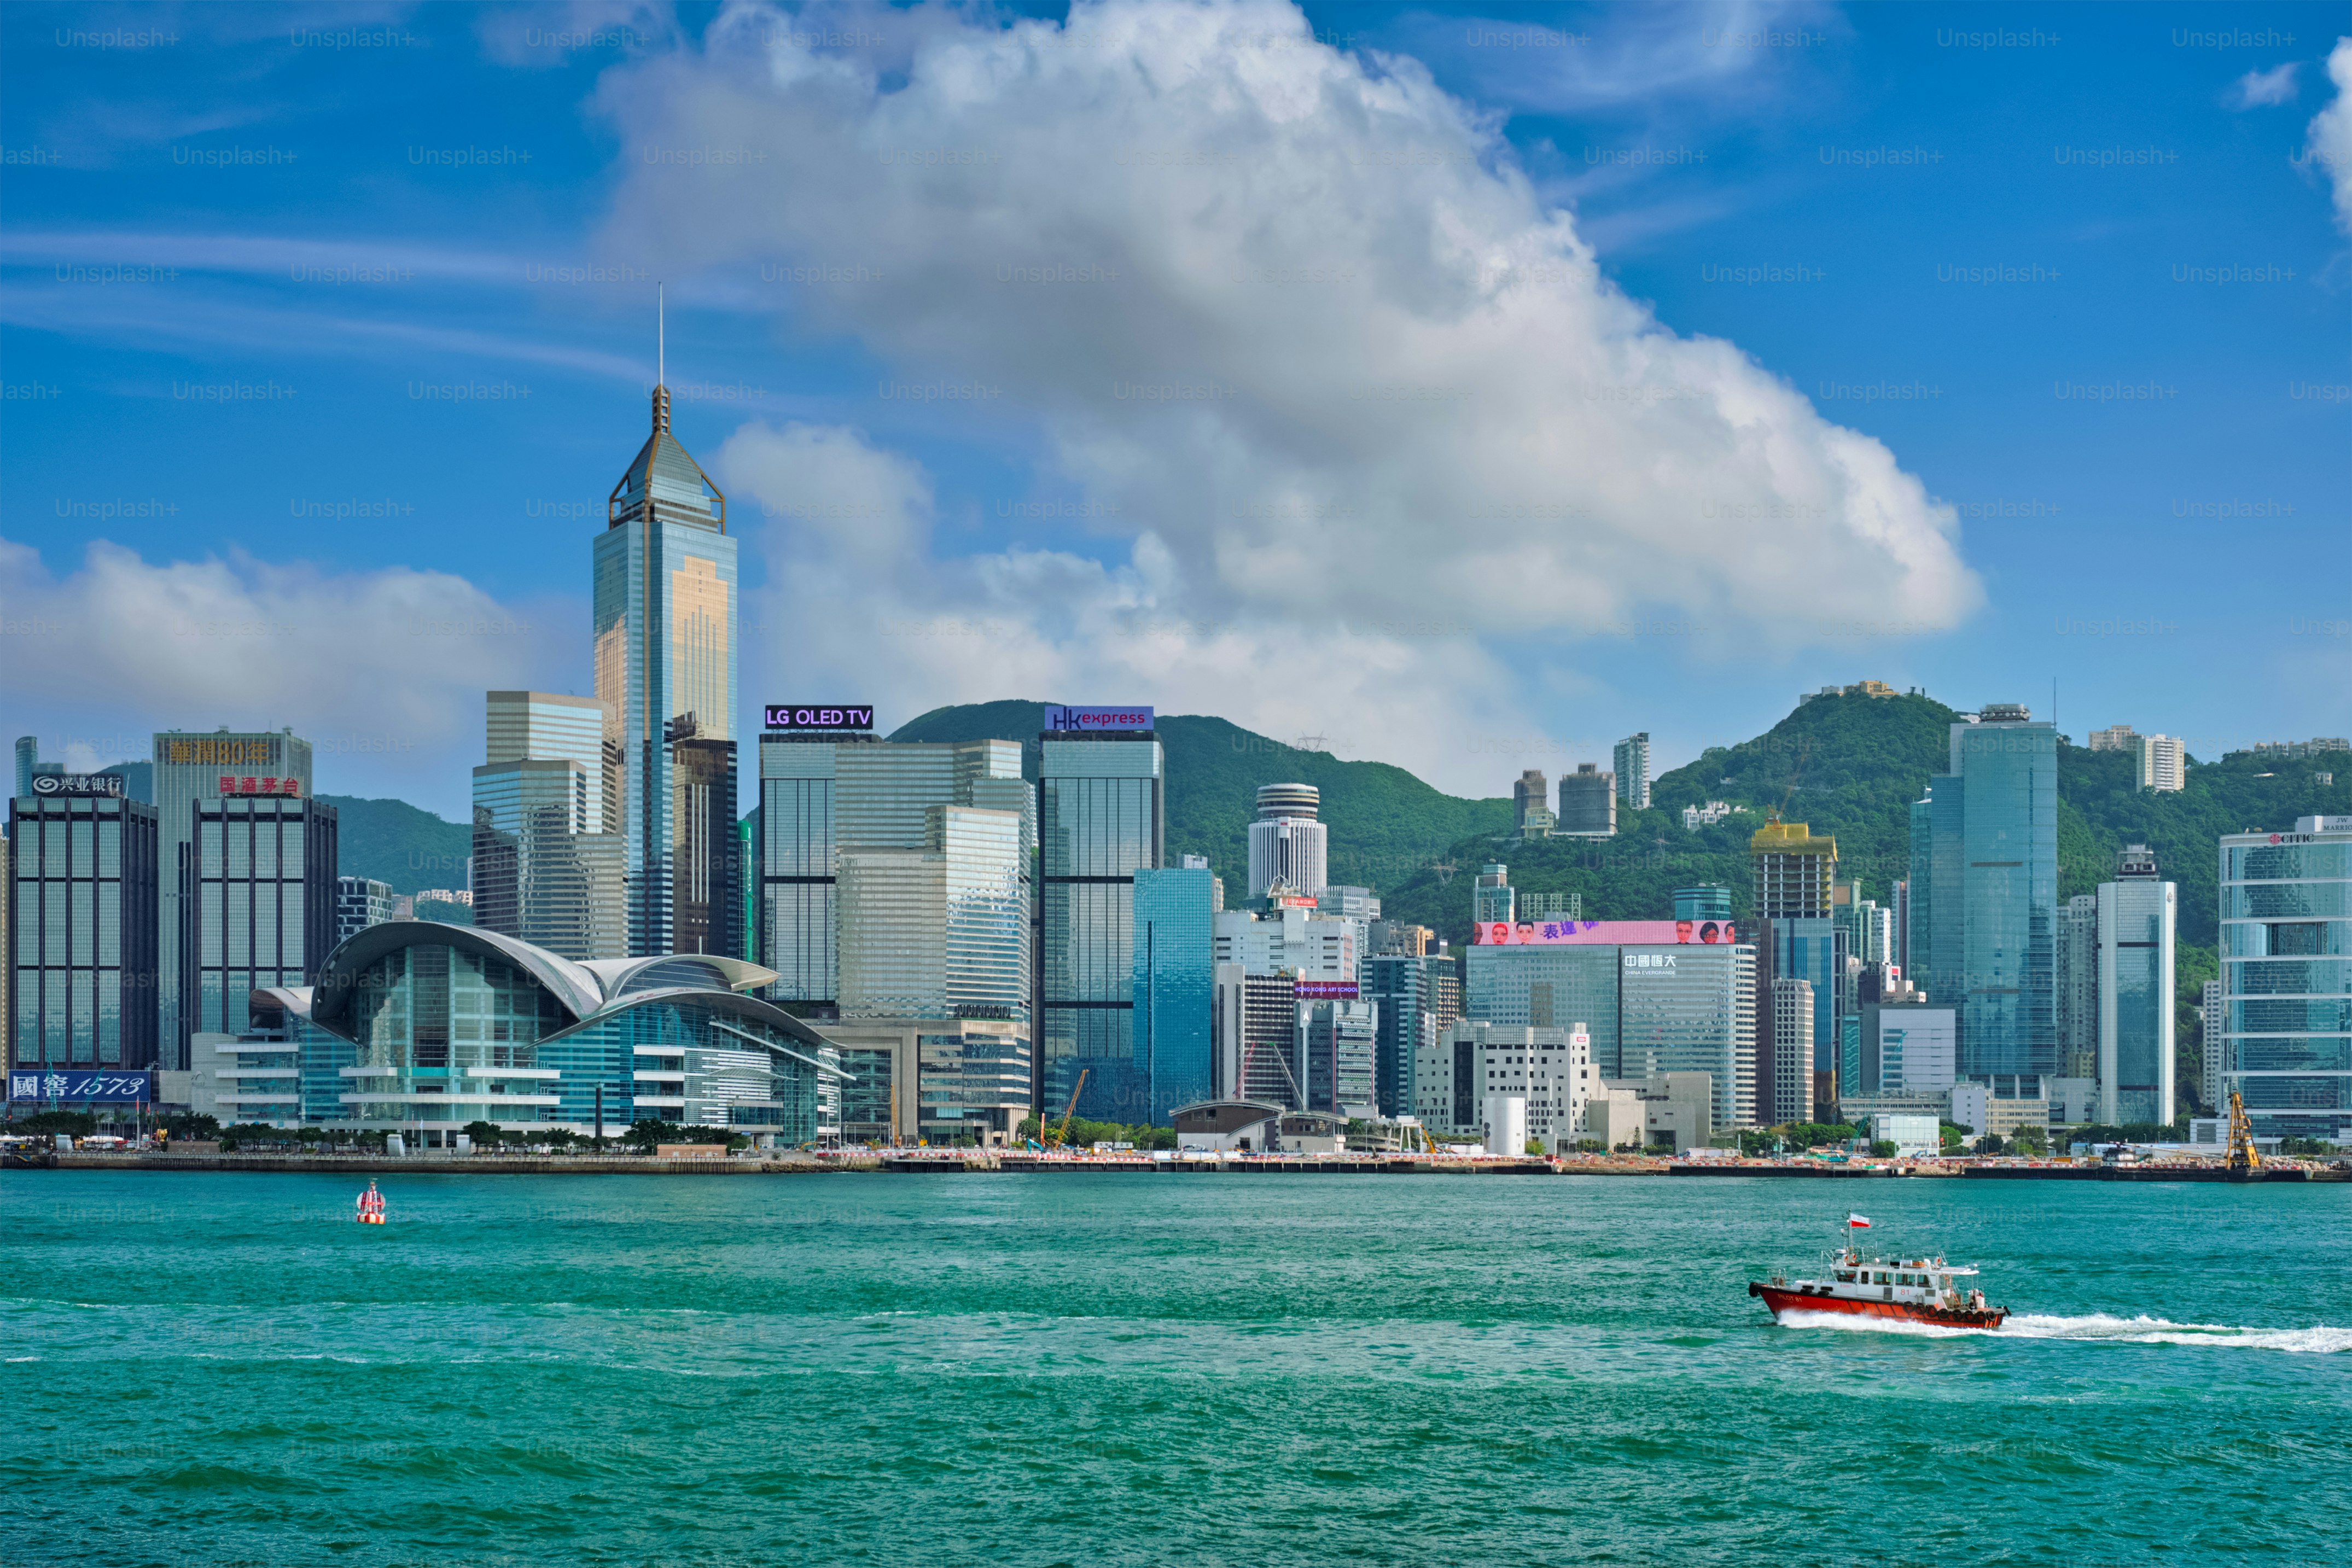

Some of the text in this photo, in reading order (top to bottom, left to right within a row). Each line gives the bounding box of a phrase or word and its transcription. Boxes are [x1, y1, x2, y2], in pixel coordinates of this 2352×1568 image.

[767, 709, 871, 725] LG OLED TV
[170, 741, 269, 764] 華潤80年
[59, 777, 121, 792] 兴业银行
[220, 777, 298, 792] 国酒茅台
[2281, 833, 2314, 843] CITIC
